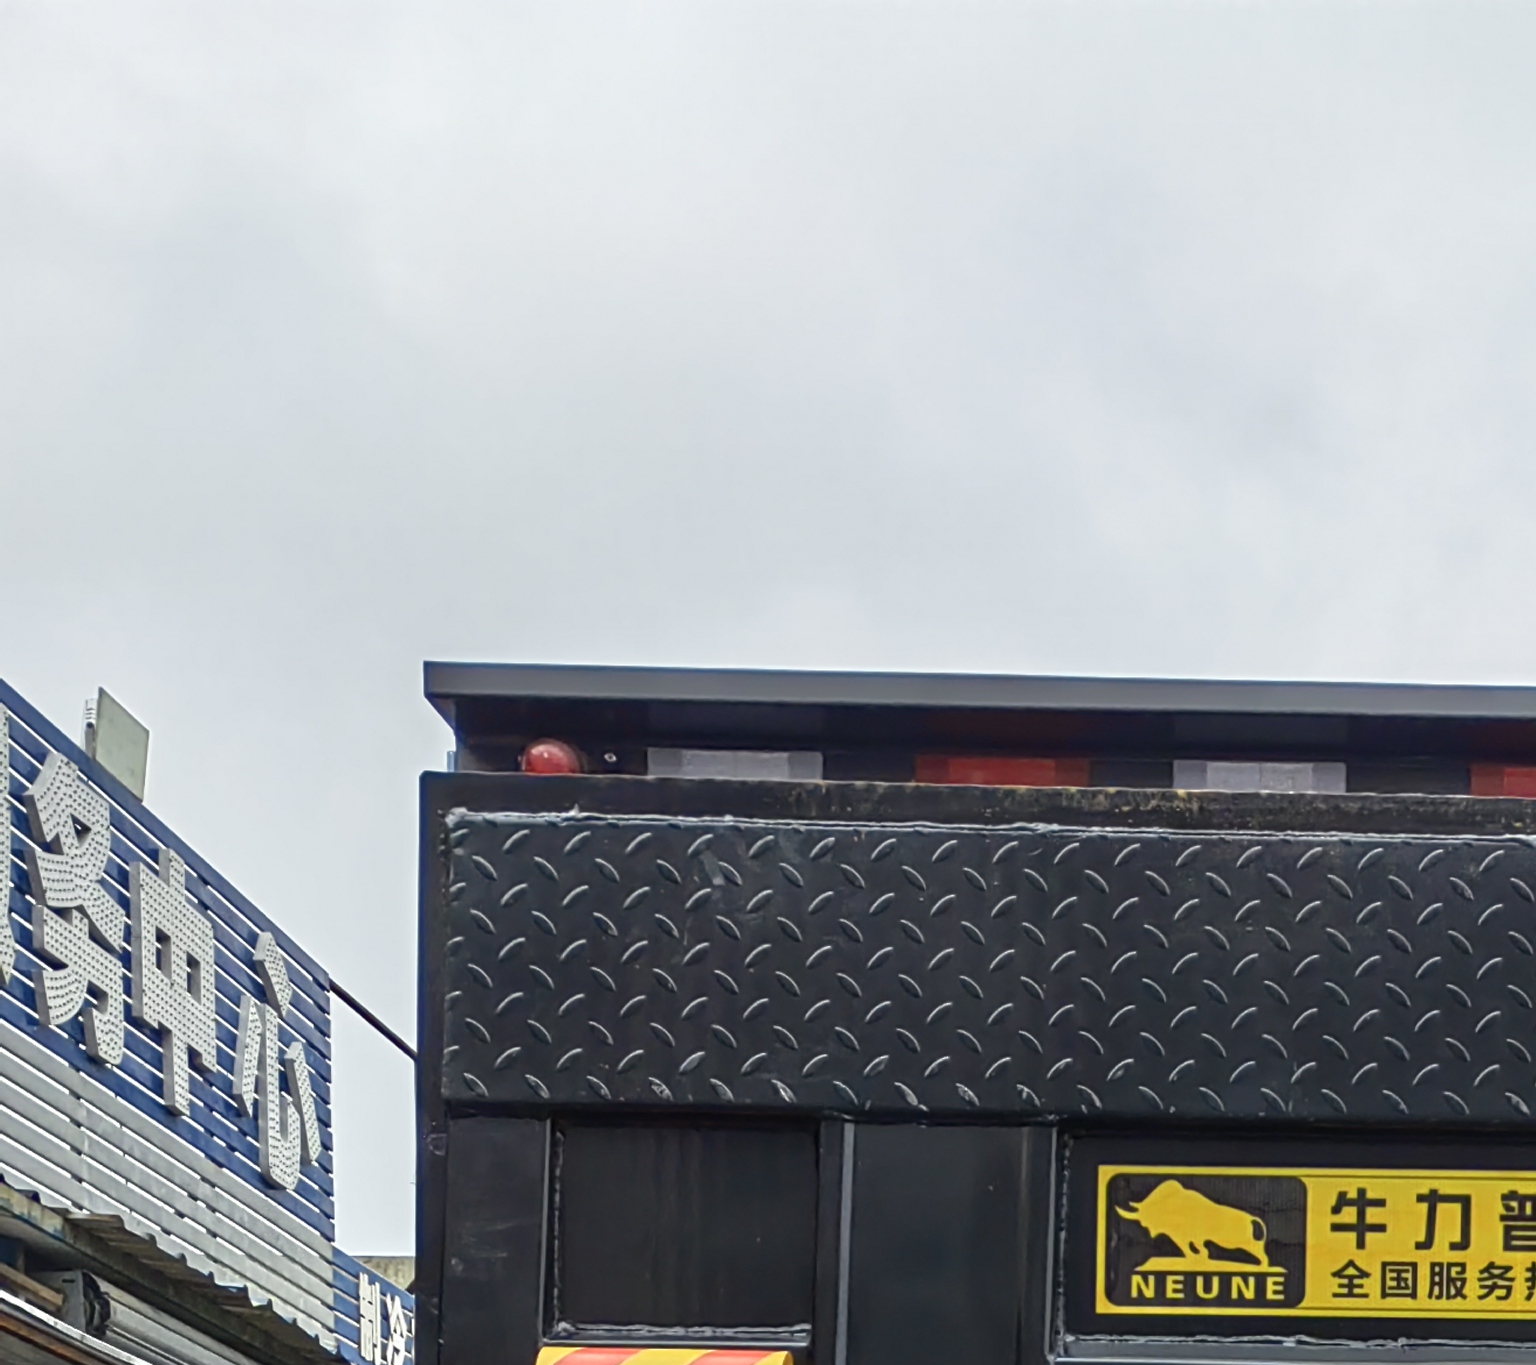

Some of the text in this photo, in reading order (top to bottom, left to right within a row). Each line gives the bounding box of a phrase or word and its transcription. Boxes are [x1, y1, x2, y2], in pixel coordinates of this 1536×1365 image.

[0, 705, 322, 1191] 务中心
[1130, 1272, 1287, 1302] NEUNE
